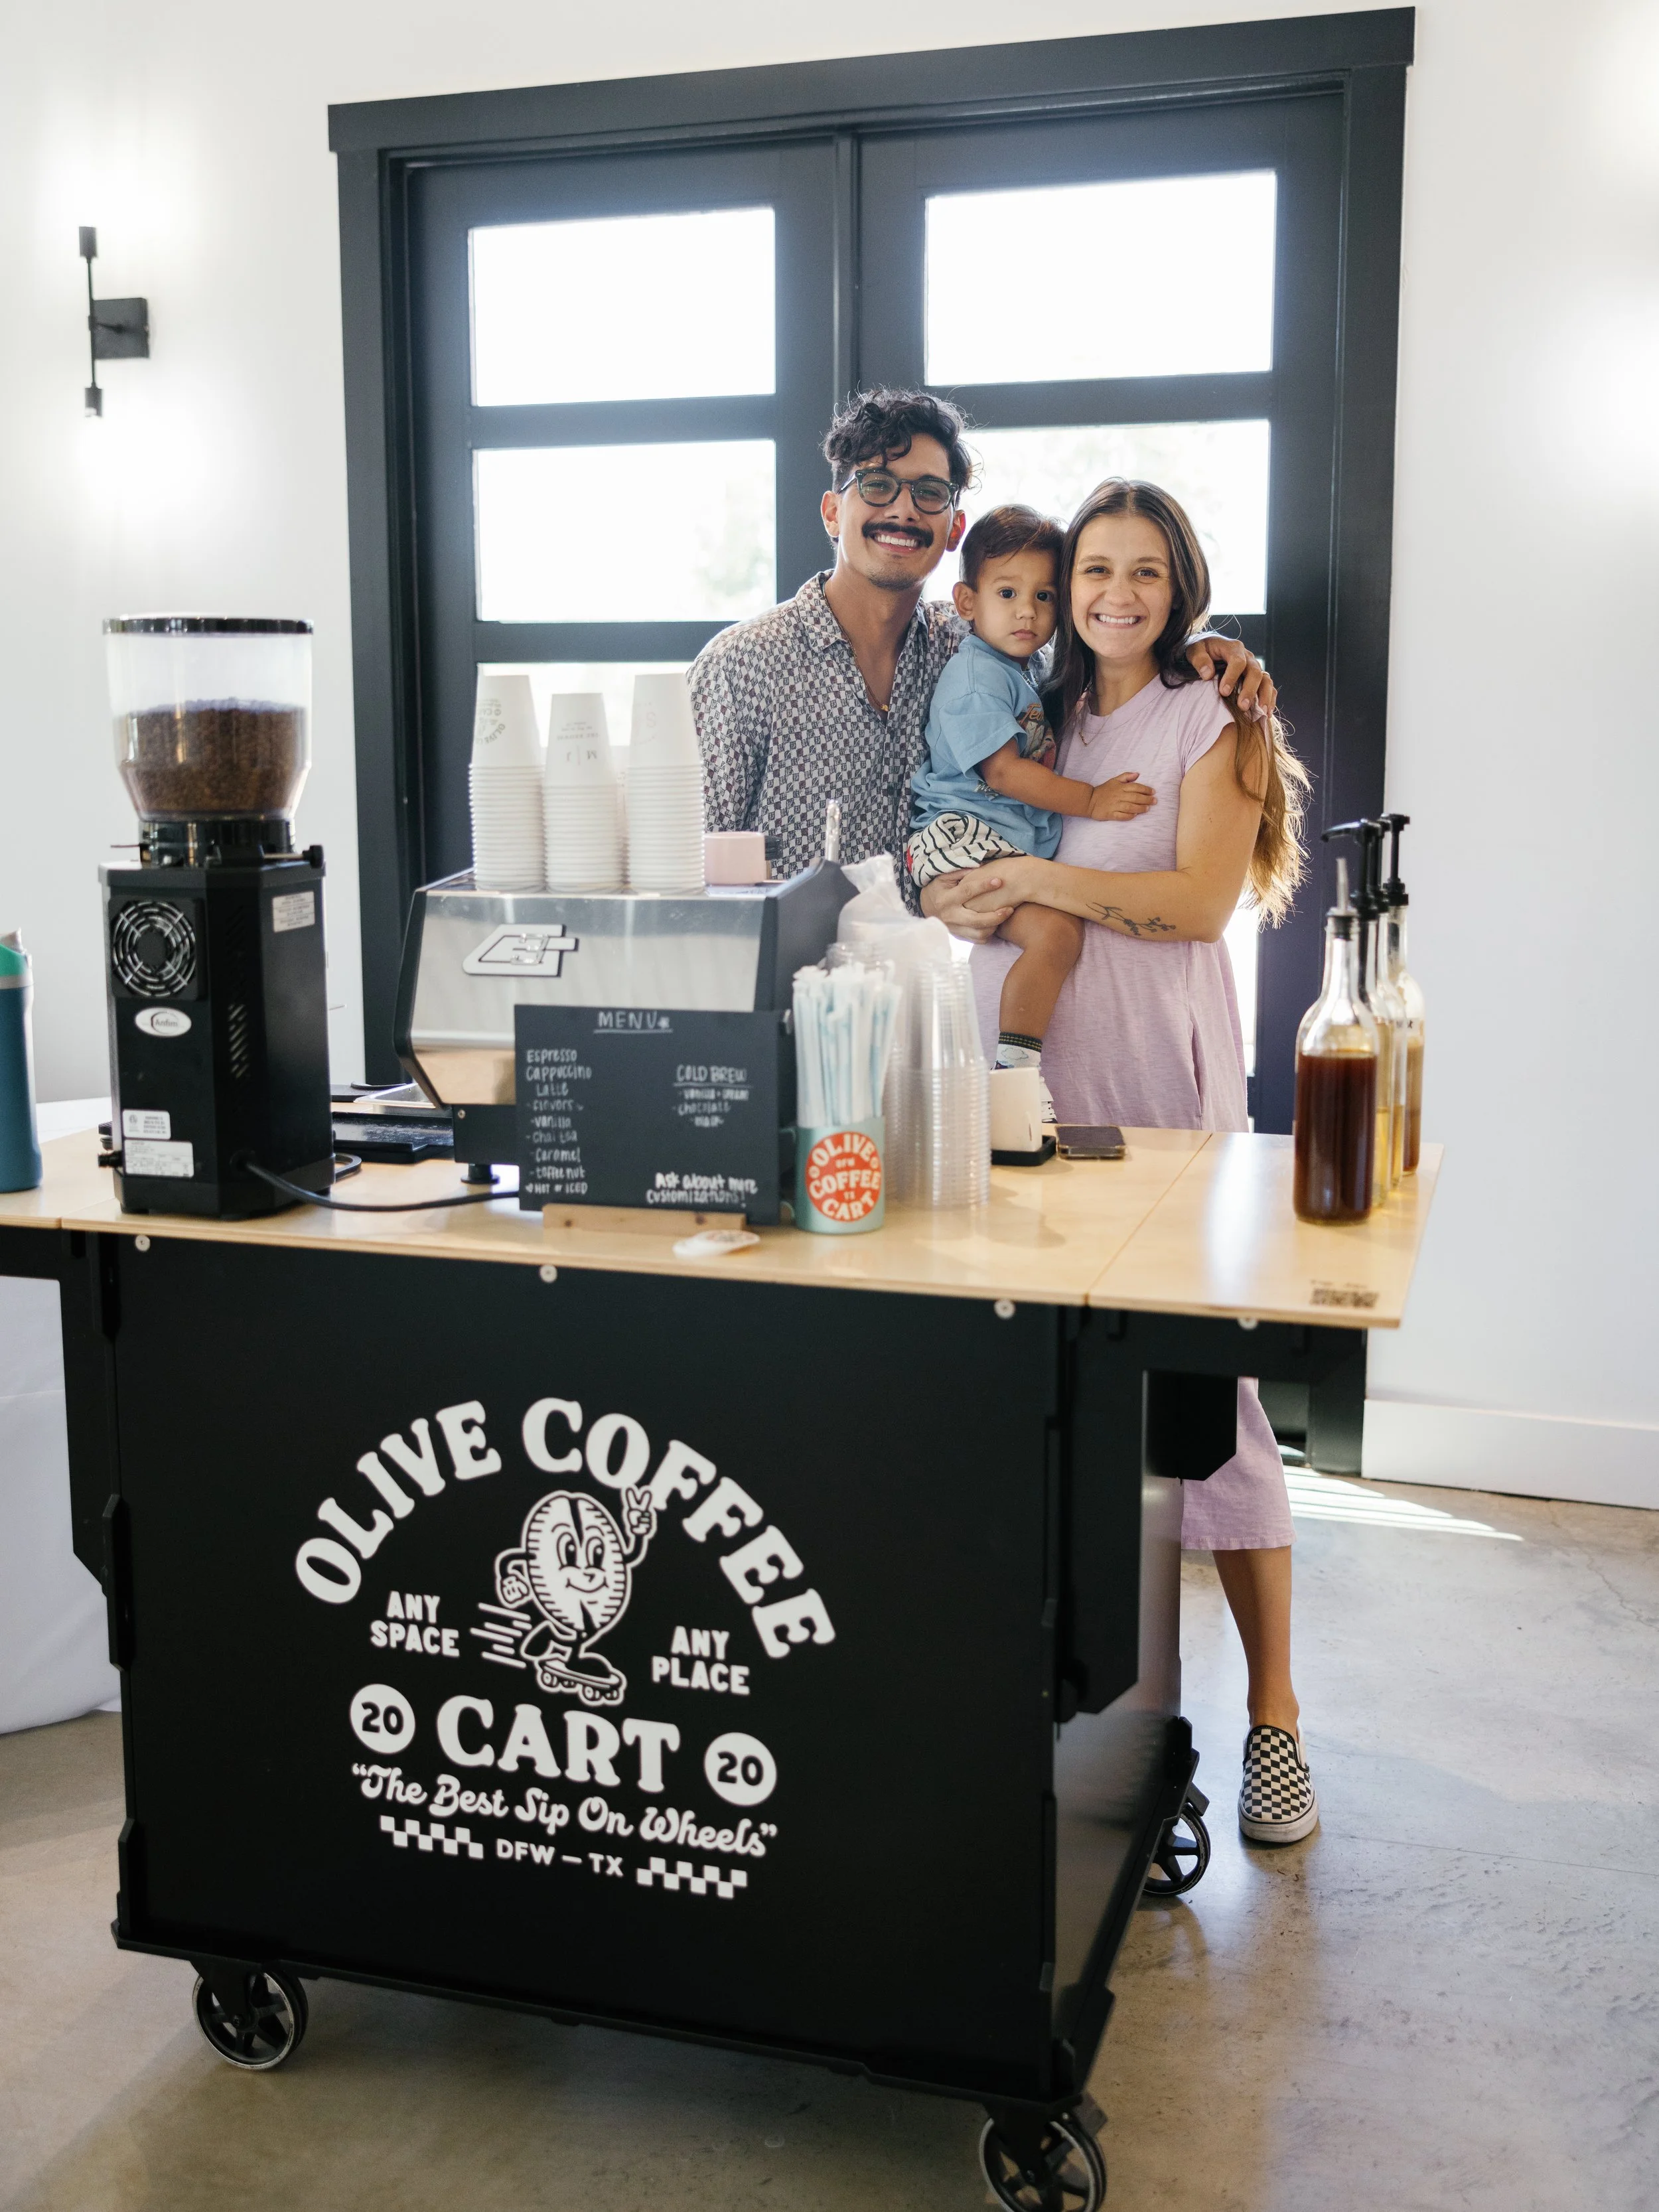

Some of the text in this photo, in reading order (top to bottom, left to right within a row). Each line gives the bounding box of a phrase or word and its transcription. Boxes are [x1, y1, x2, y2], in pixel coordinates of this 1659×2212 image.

[599, 1010, 658, 1029] MENU
[676, 1064, 748, 1083] COLD BREW
[812, 1133, 876, 1167] OLIVE
[809, 1169, 882, 1200] COFFEE
[822, 1191, 875, 1220] CART
[295, 1397, 836, 1659] OLIVE COFFEE
[386, 1590, 441, 1624] ANY
[370, 1620, 460, 1658] SPACE
[670, 1625, 730, 1661] ANY
[652, 1655, 751, 1696] PLACE
[360, 1702, 399, 1735] 20
[436, 1694, 682, 1794] CART
[716, 1751, 760, 1787] 20
[428, 1773, 510, 1818] Best
[514, 1786, 571, 1836] Sip
[577, 1795, 635, 1837] On
[496, 1838, 555, 1866] DFW
[588, 1852, 624, 1878] TX
